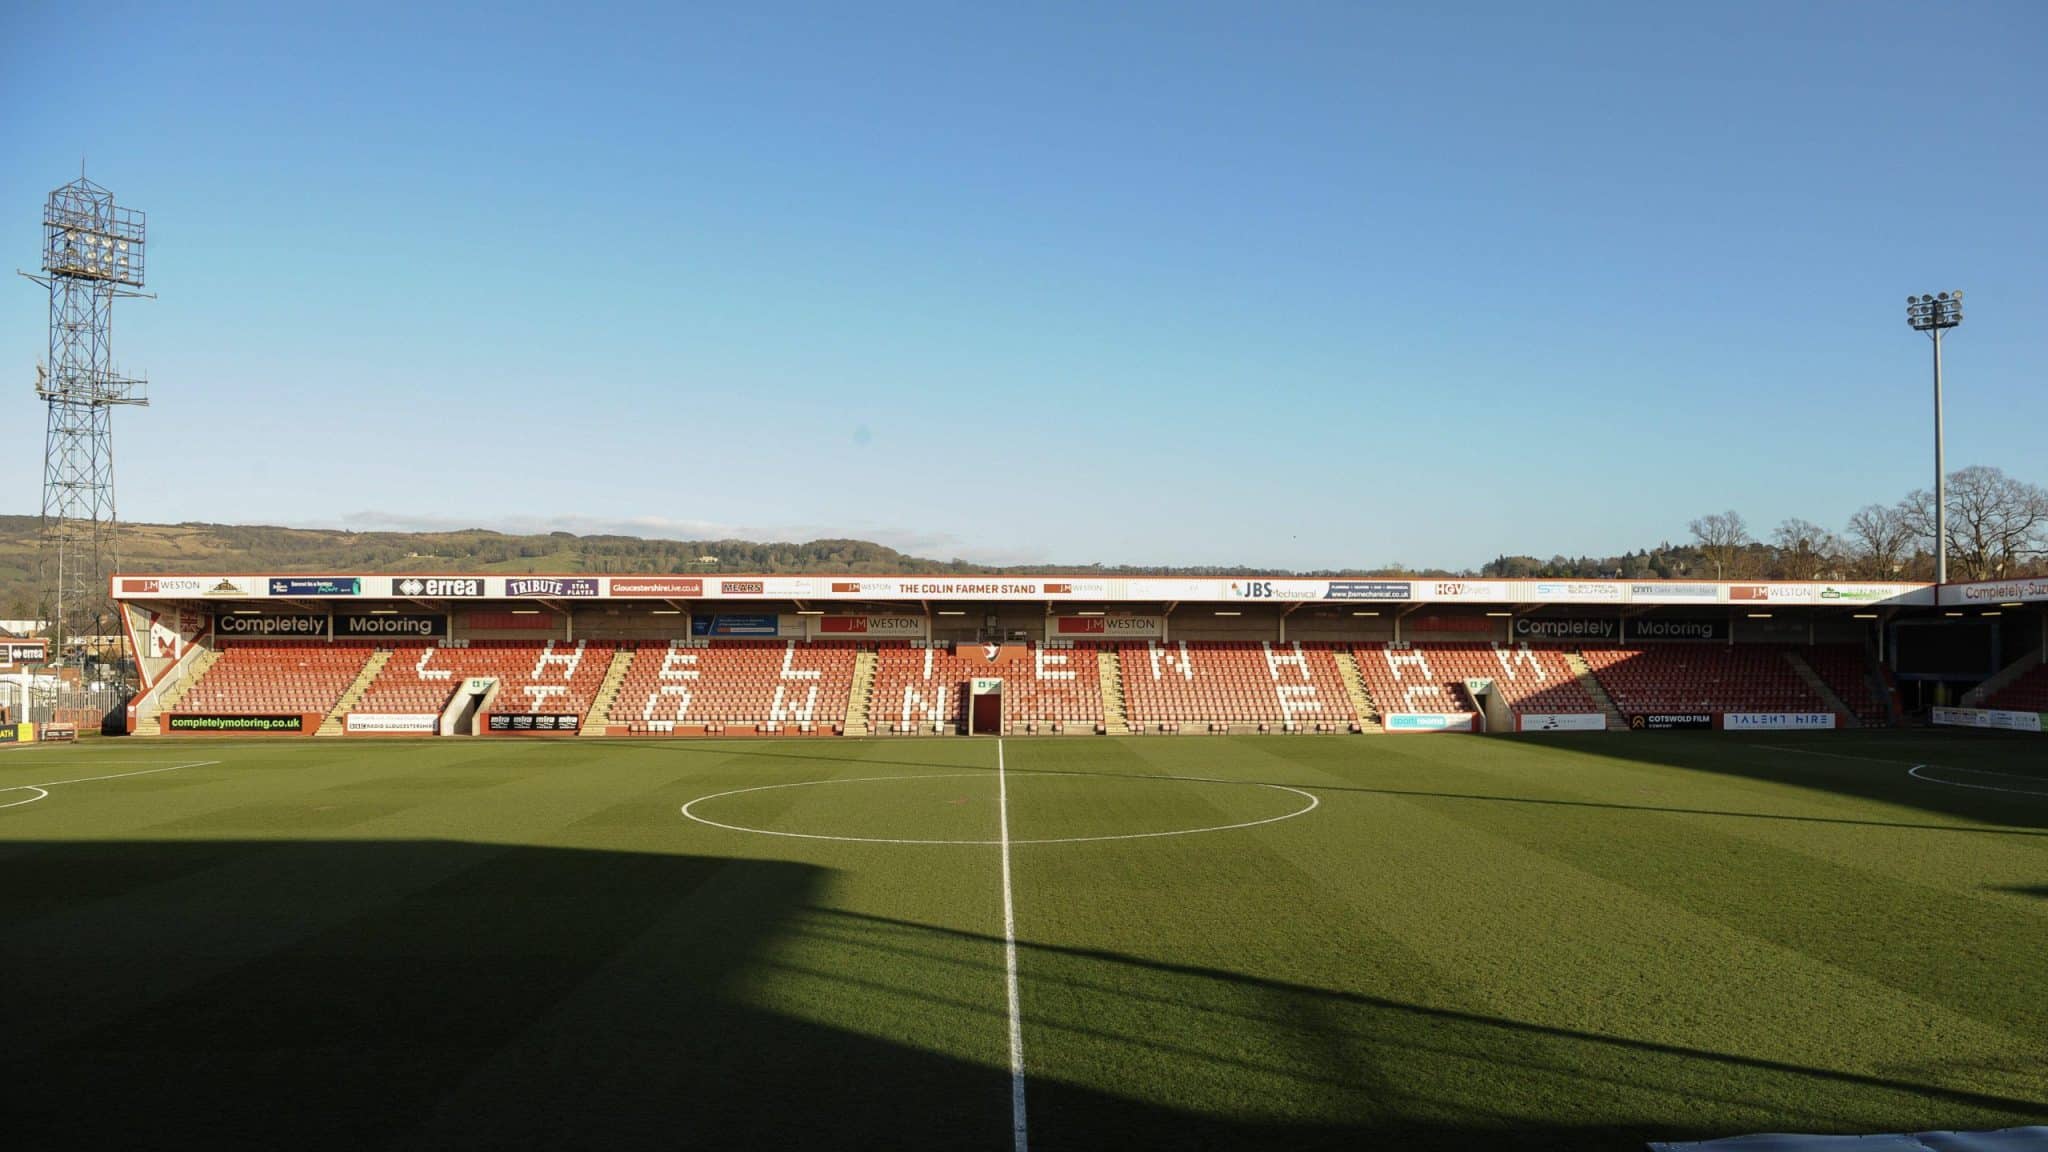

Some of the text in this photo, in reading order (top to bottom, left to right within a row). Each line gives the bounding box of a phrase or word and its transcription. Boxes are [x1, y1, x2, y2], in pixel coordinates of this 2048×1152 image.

[143, 580, 159, 591] J.M
[160, 581, 200, 589] WESTON
[426, 579, 477, 595] errea
[510, 579, 563, 595] TRIBUTE
[612, 583, 701, 593] GloucestershireLive.co.uk
[724, 583, 761, 592] MEARS
[848, 583, 860, 592] J.M
[899, 584, 1036, 594] THE COLIN FARMER STAND
[1244, 582, 1272, 598] JBS
[1435, 584, 1464, 595] HGV
[1752, 587, 1768, 598] J.M
[1769, 588, 1811, 597] WESTON
[220, 615, 432, 634] Completely Motoring
[848, 618, 867, 631] J.M
[869, 618, 919, 628] WESTON
[1086, 619, 1155, 631] J.M WESTON
[1517, 618, 1712, 638] Completely Motoring
[171, 717, 301, 730] completelymotoring.co.uk
[1649, 715, 1710, 723] COTSWOLD FILM
[1796, 715, 1828, 724] HIRE
